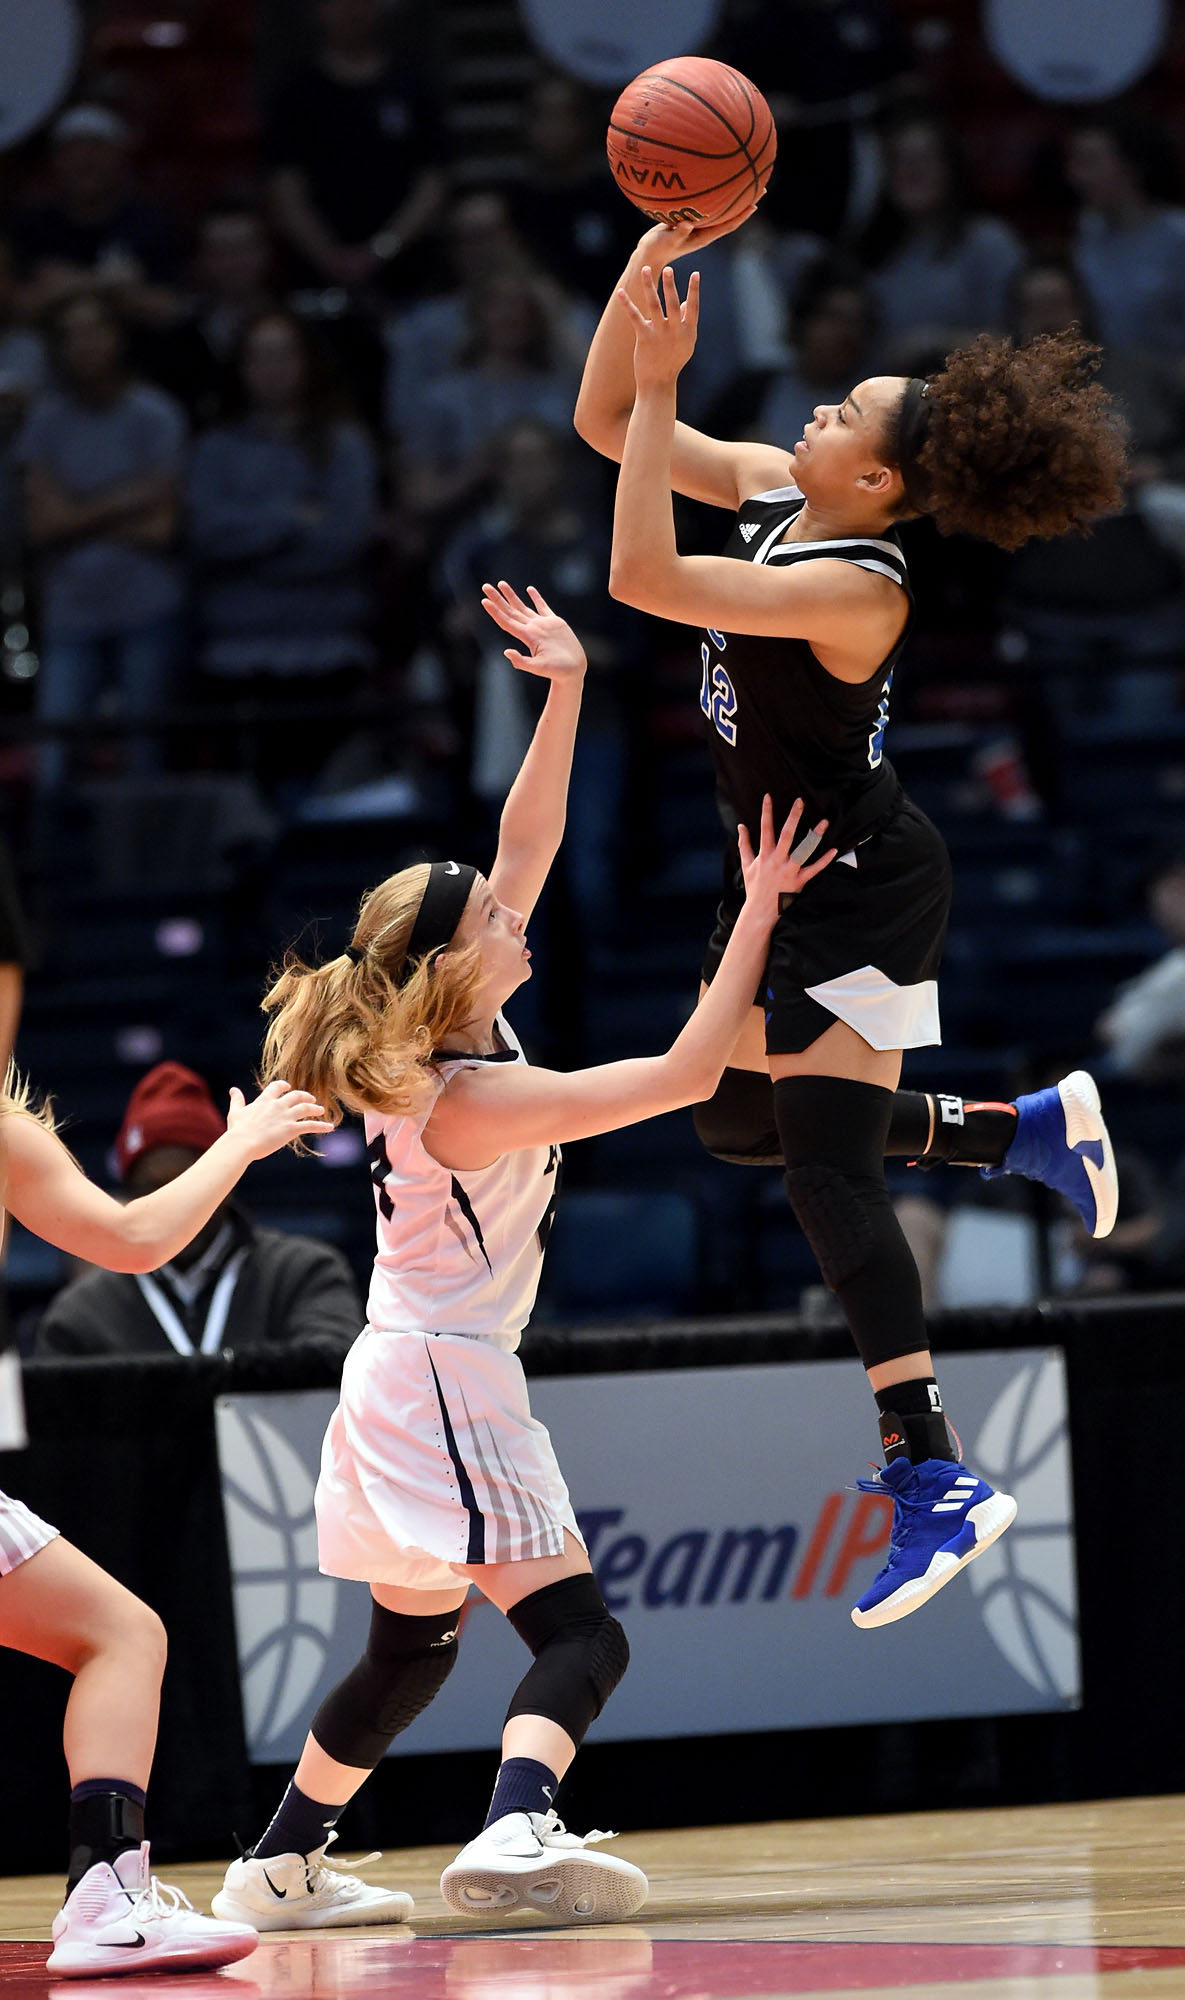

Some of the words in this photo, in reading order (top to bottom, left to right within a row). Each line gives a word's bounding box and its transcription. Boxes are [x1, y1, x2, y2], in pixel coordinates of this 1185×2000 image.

[613, 159, 687, 190] WAV
[700, 641, 738, 748] 12
[577, 1492, 894, 1609] TeamIP
